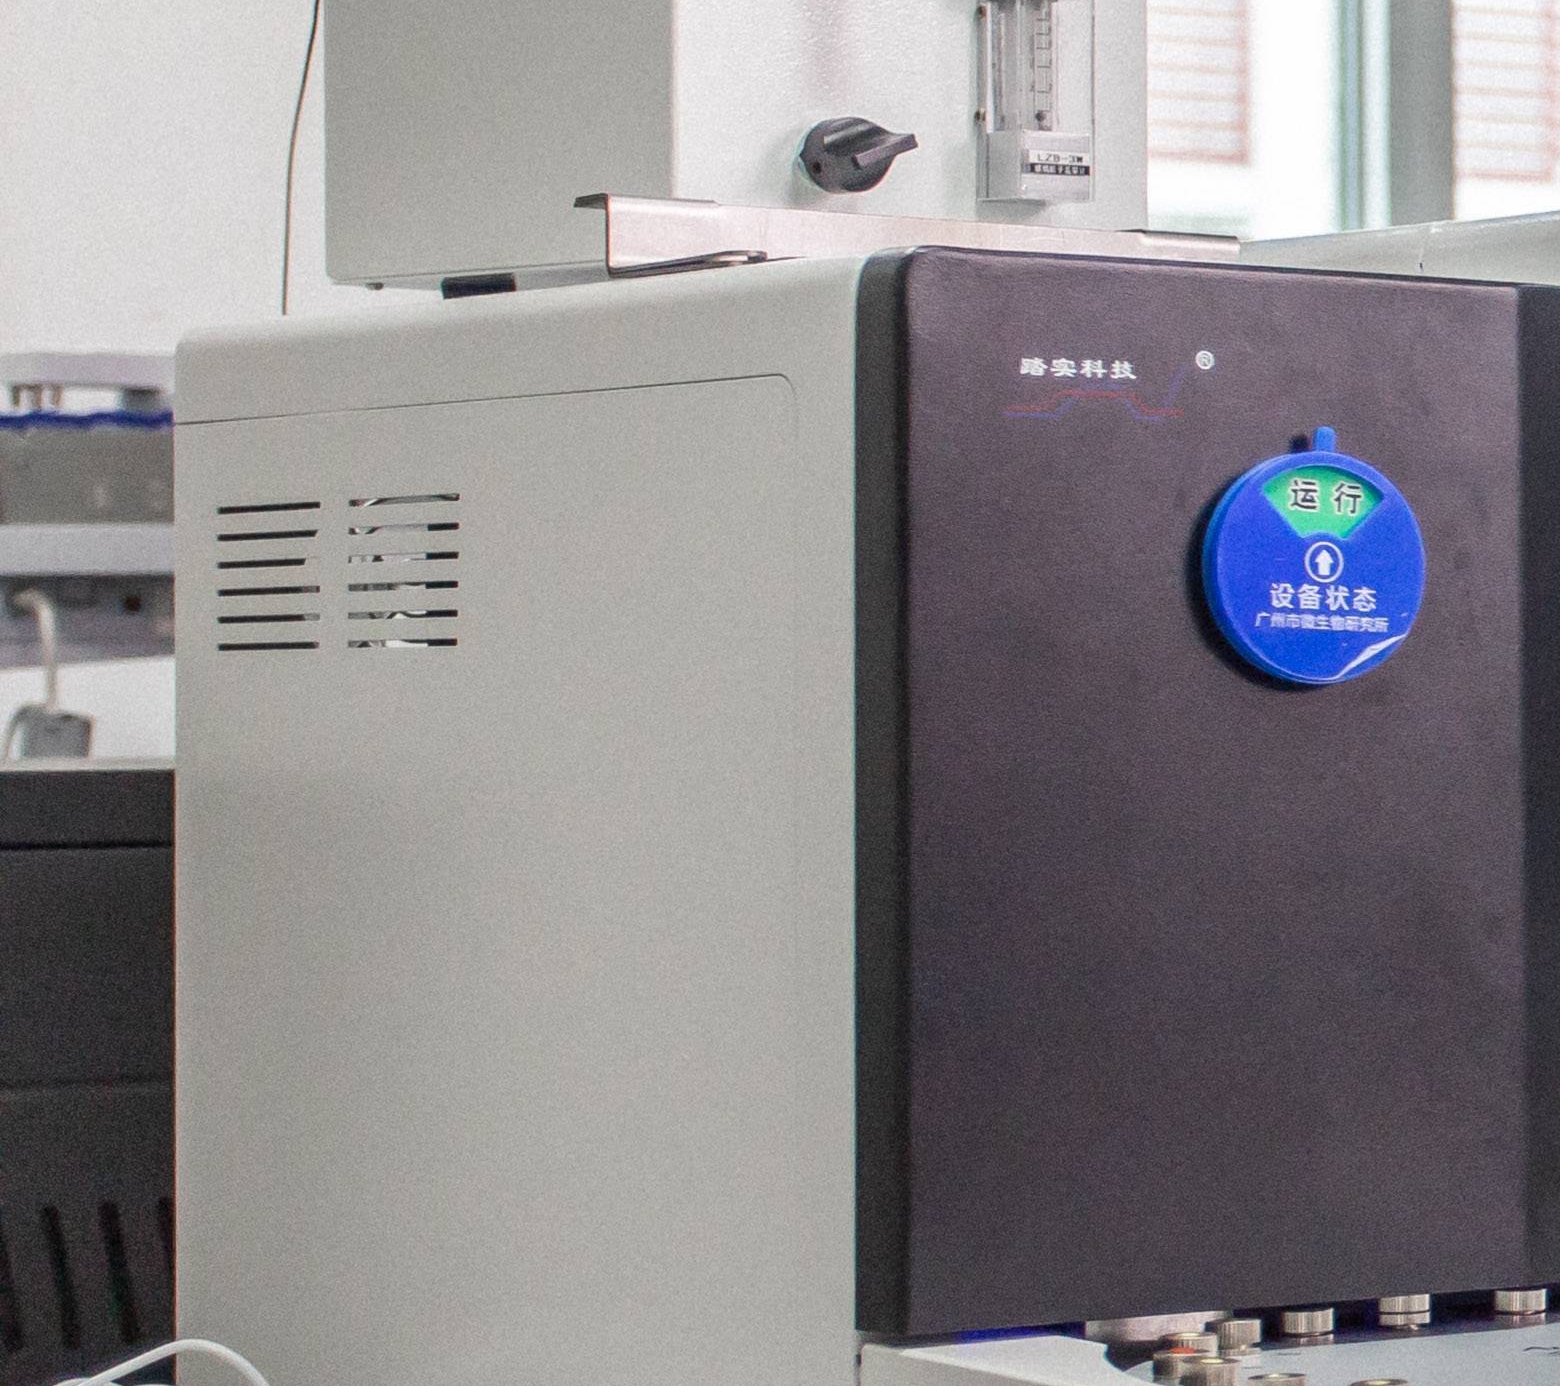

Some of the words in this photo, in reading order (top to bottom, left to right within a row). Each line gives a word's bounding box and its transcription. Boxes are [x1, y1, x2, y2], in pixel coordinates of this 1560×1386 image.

[1020, 357, 1137, 379] 踏实科技
[1288, 480, 1363, 516] 运行
[1270, 582, 1377, 612] 设备状态
